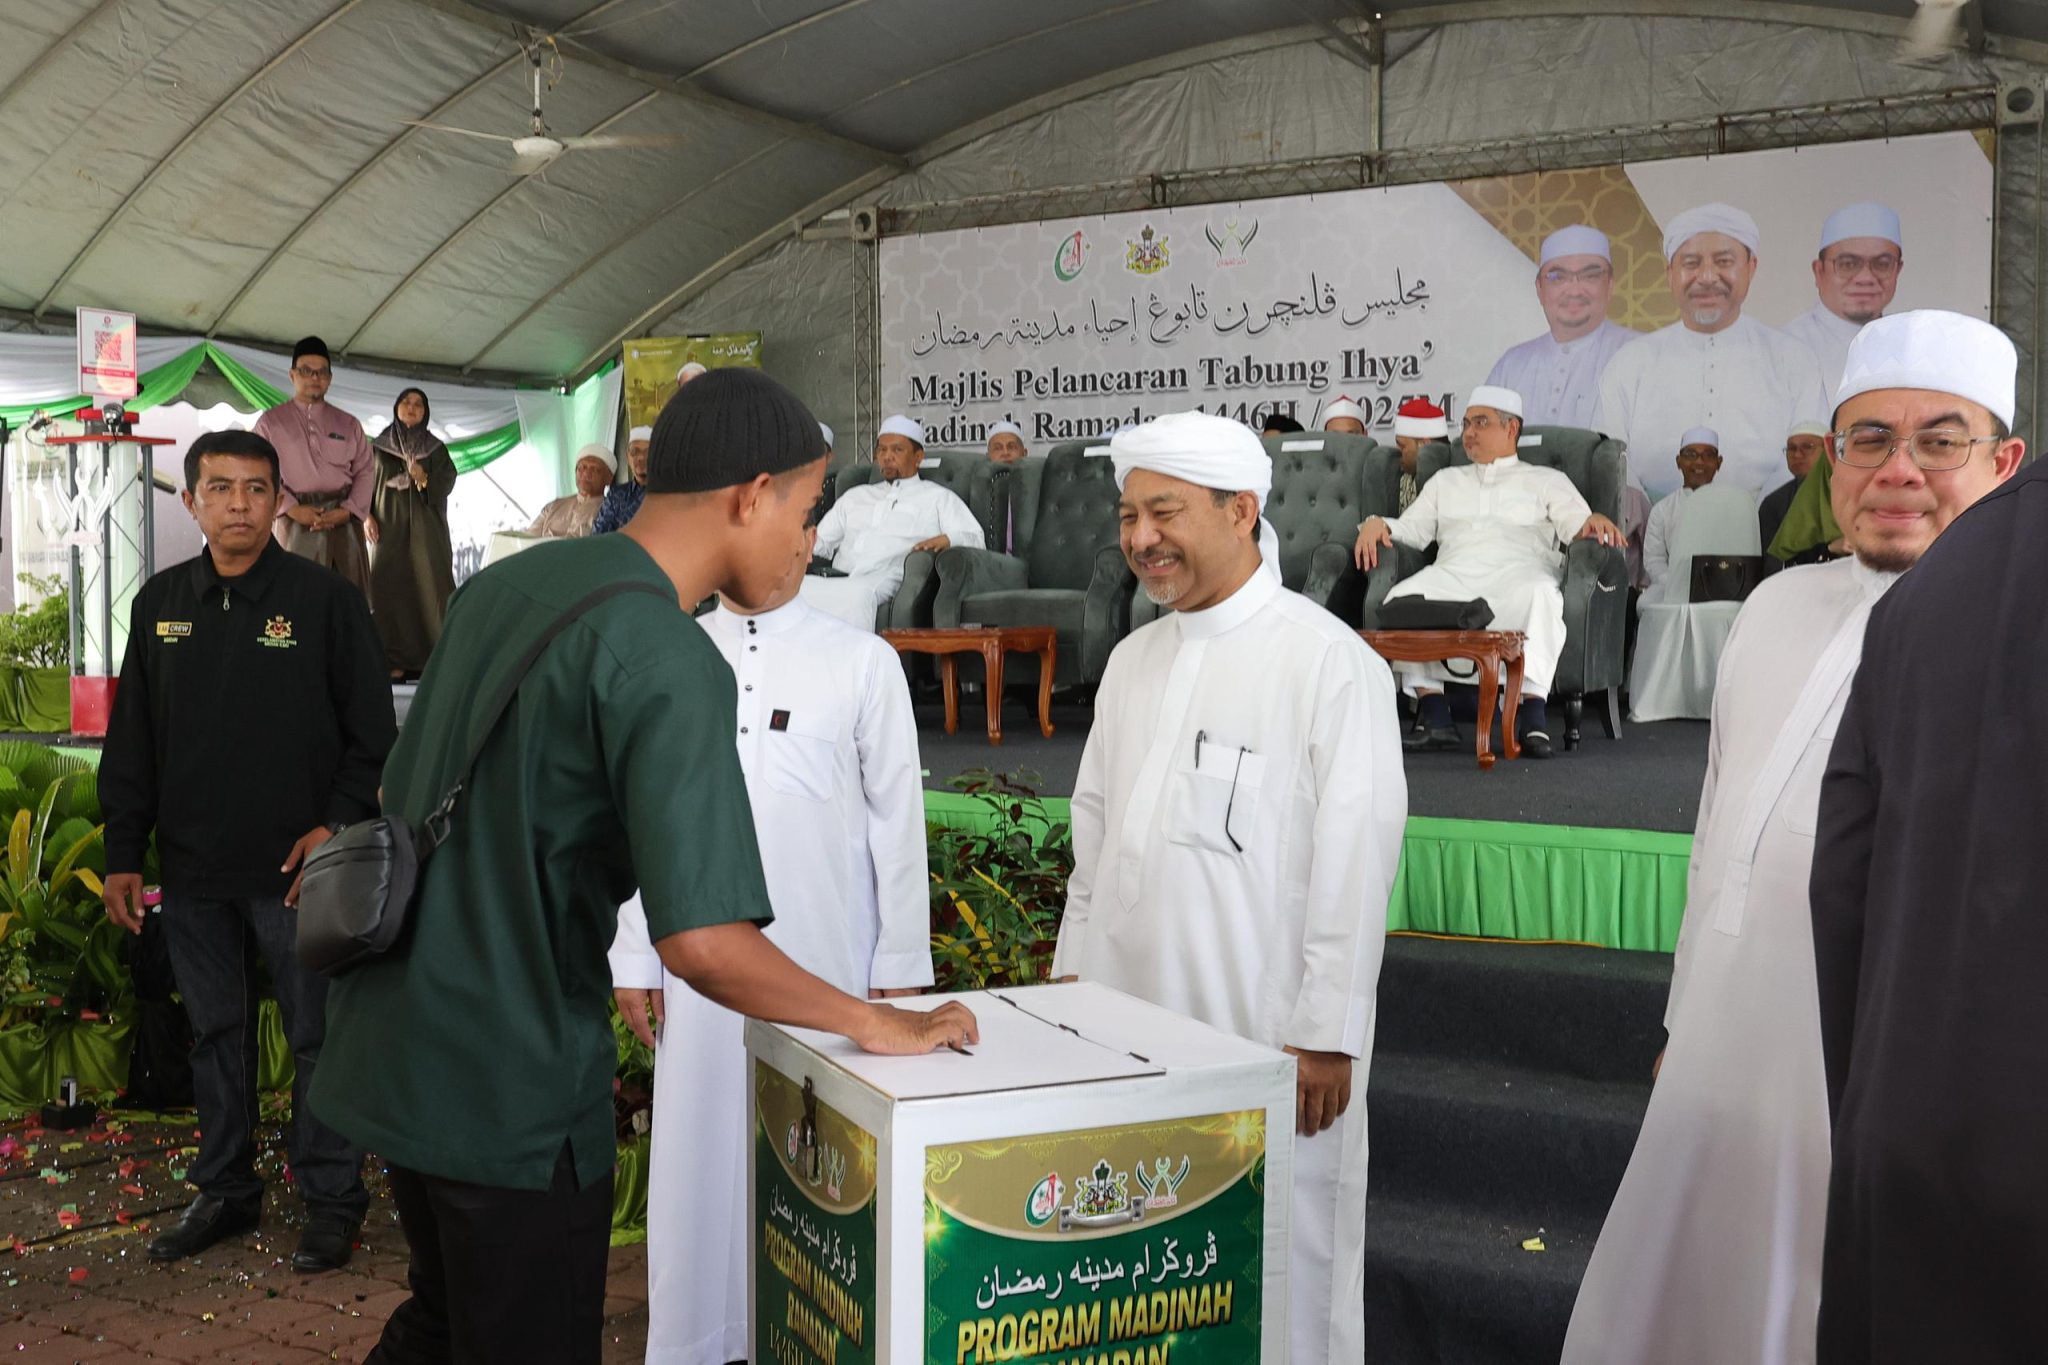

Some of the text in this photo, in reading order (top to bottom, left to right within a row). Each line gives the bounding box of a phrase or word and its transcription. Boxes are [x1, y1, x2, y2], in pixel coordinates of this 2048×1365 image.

[1341, 266, 1430, 326] مجليس
[912, 309, 1004, 357] رمضان
[910, 370, 1003, 407] Majlis
[1014, 366, 1189, 398] Pelancaran
[1199, 355, 1330, 389] Tabung
[169, 624, 189, 633] CREW
[764, 1218, 863, 1347] PROGRAM MADINAH
[975, 1265, 1063, 1310] رمضان
[786, 1288, 837, 1365] RAMADAN
[956, 1280, 1234, 1365] PROGRAM MADINAH
